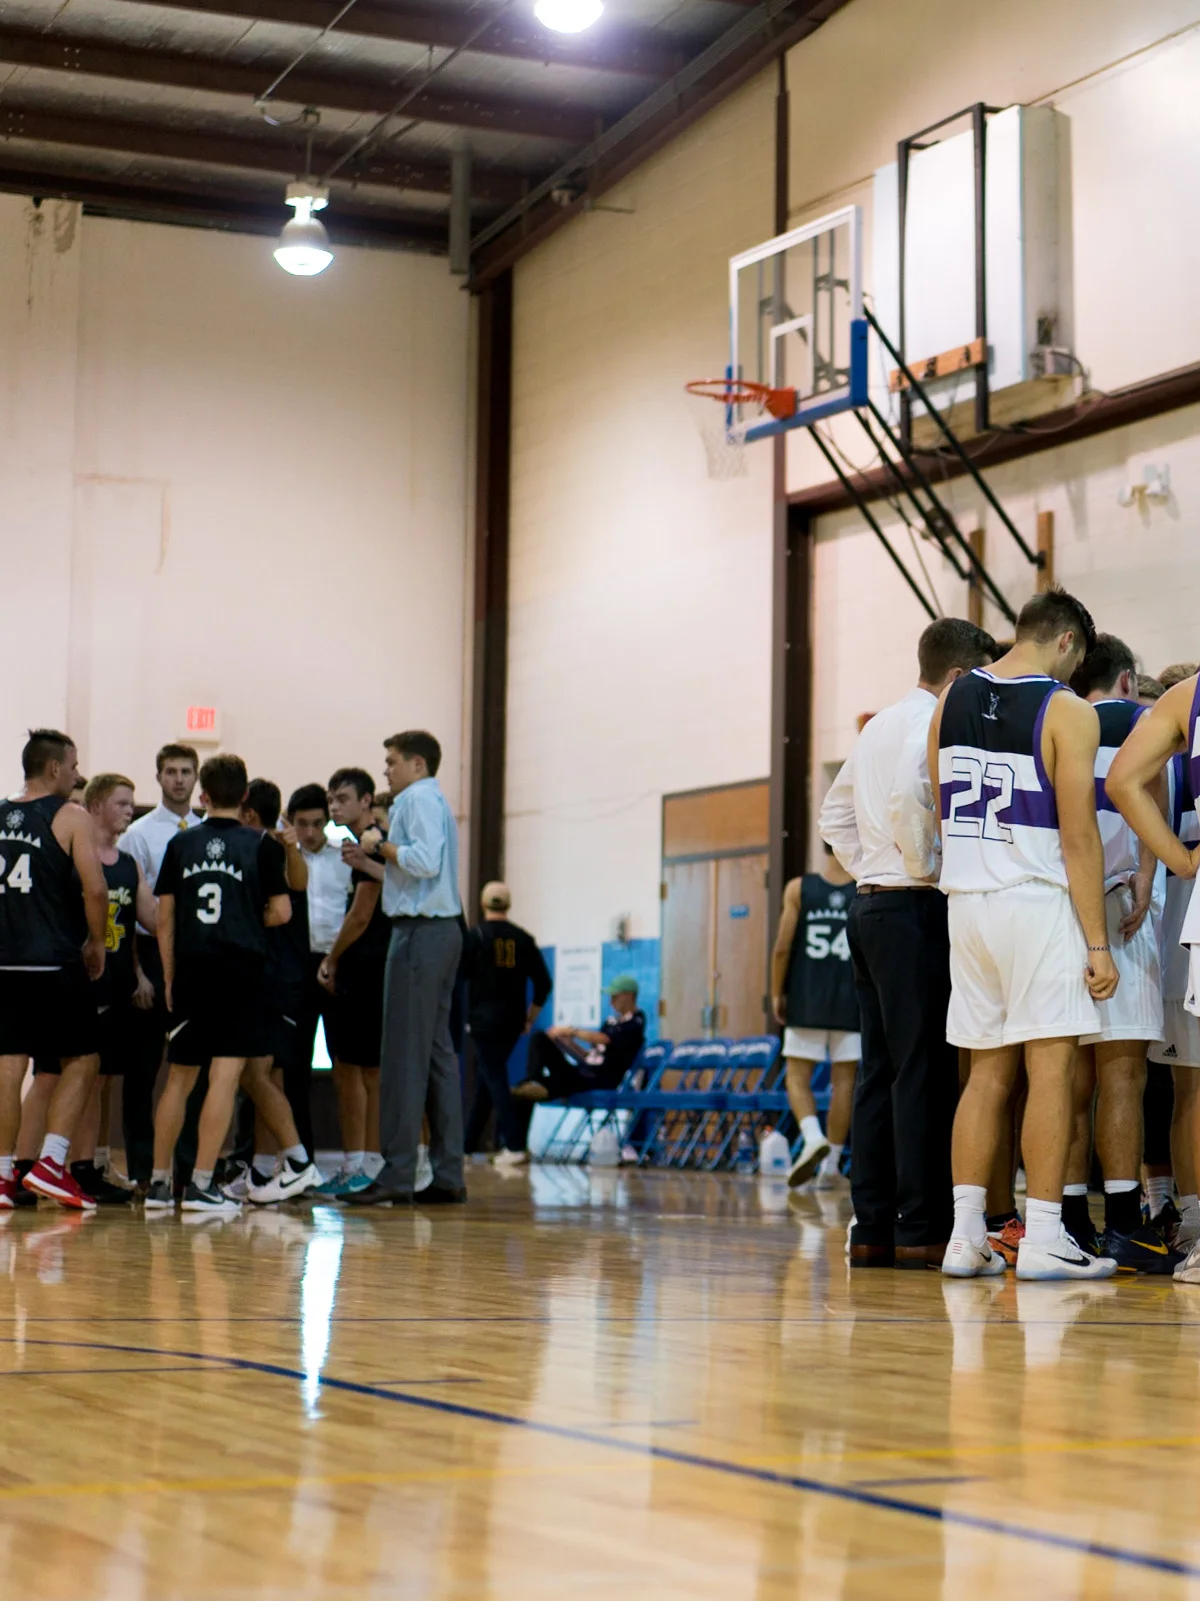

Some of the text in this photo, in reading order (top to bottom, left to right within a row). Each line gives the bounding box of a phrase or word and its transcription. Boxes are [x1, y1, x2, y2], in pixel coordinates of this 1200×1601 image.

[947, 756, 1014, 844] 22
[0, 852, 33, 894] 4
[196, 883, 222, 924] 3
[806, 924, 850, 961] 54
